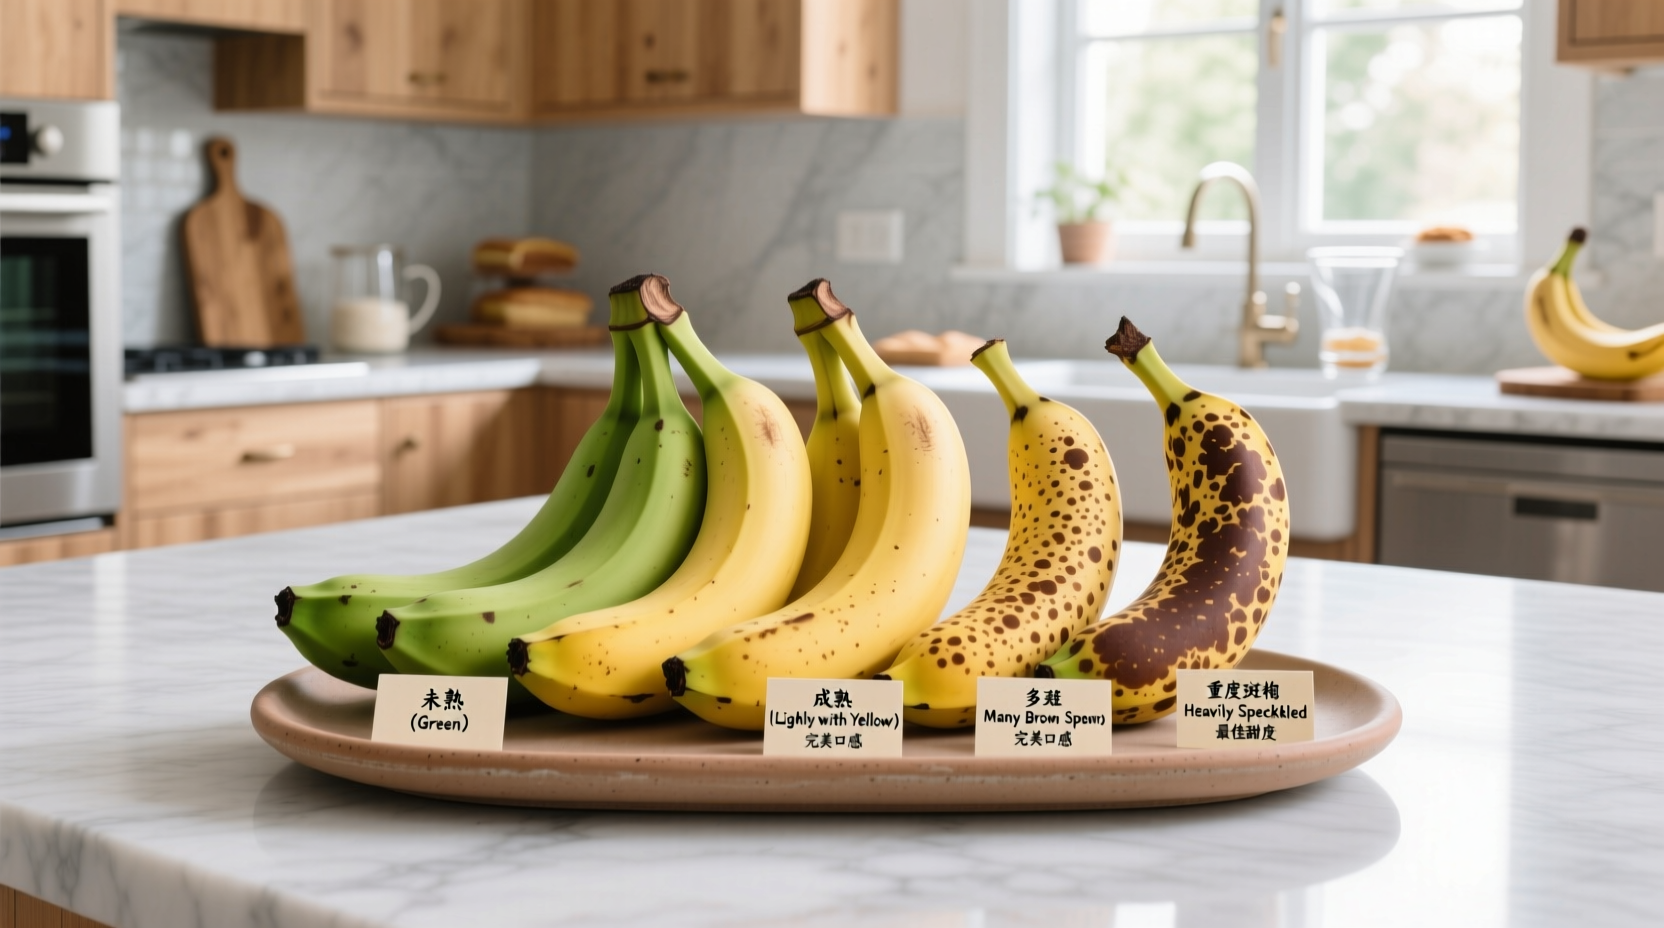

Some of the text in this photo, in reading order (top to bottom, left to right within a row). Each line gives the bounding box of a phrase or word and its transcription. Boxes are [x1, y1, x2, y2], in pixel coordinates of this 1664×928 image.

[421, 688, 464, 711] 未熟
[813, 688, 853, 708] 成熟
[818, 711, 847, 726] with
[850, 712, 899, 730] Yellow)
[984, 709, 1021, 728] Many
[1184, 703, 1234, 721] Heavily
[410, 713, 469, 732] (Green)
